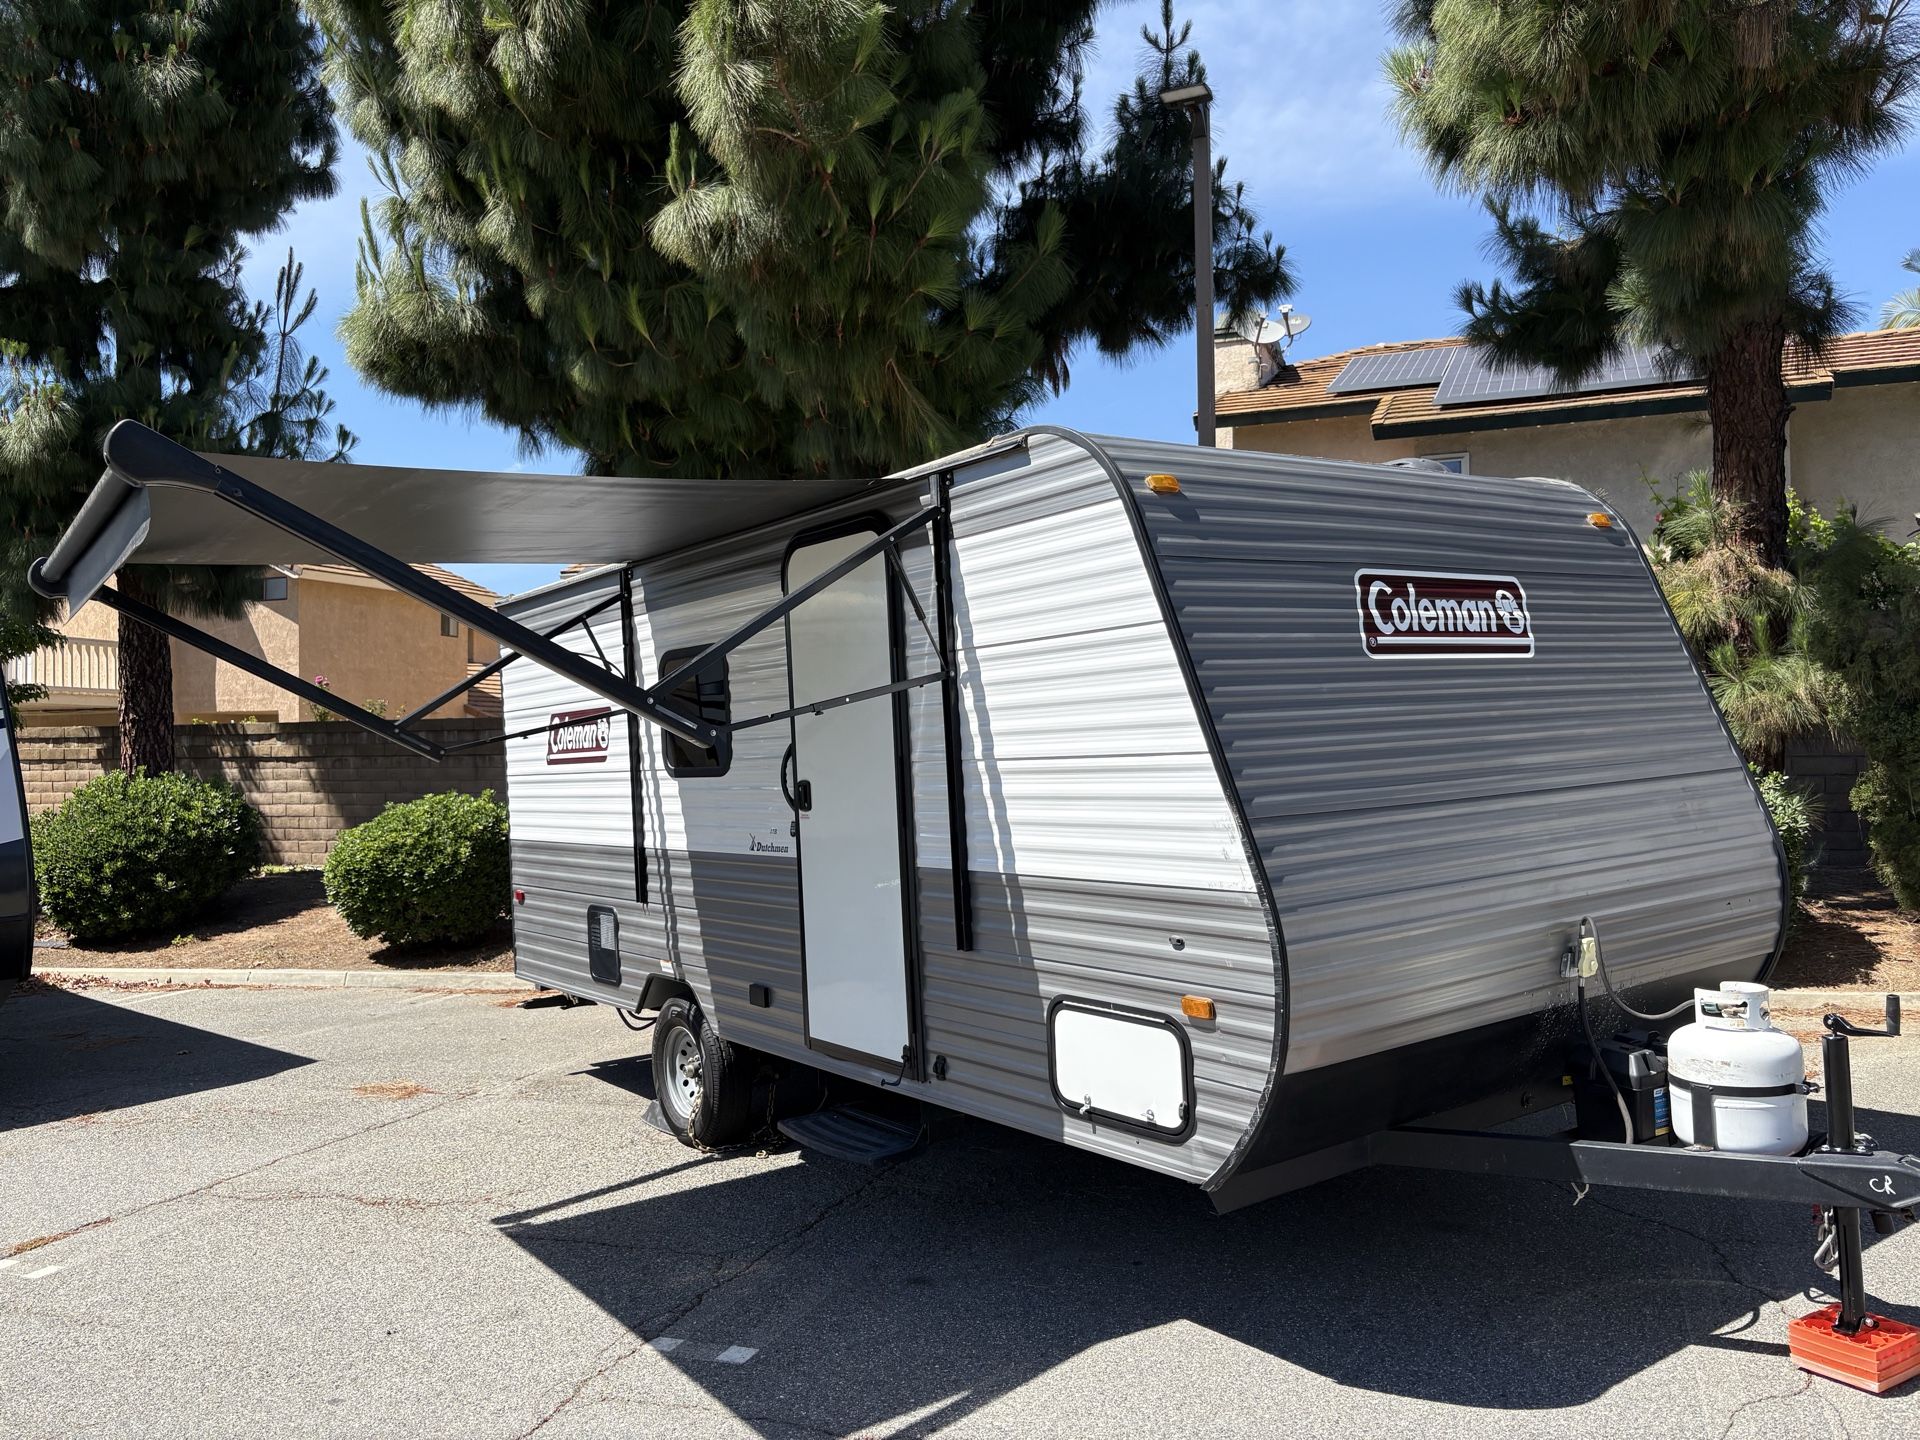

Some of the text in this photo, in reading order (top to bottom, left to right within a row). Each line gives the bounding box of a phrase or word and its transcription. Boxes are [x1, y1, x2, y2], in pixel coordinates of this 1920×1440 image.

[1368, 581, 1497, 634] Coleman
[550, 716, 597, 753] Coleman
[756, 841, 789, 853] Dutchmen
[1869, 1174, 1896, 1195] CR
